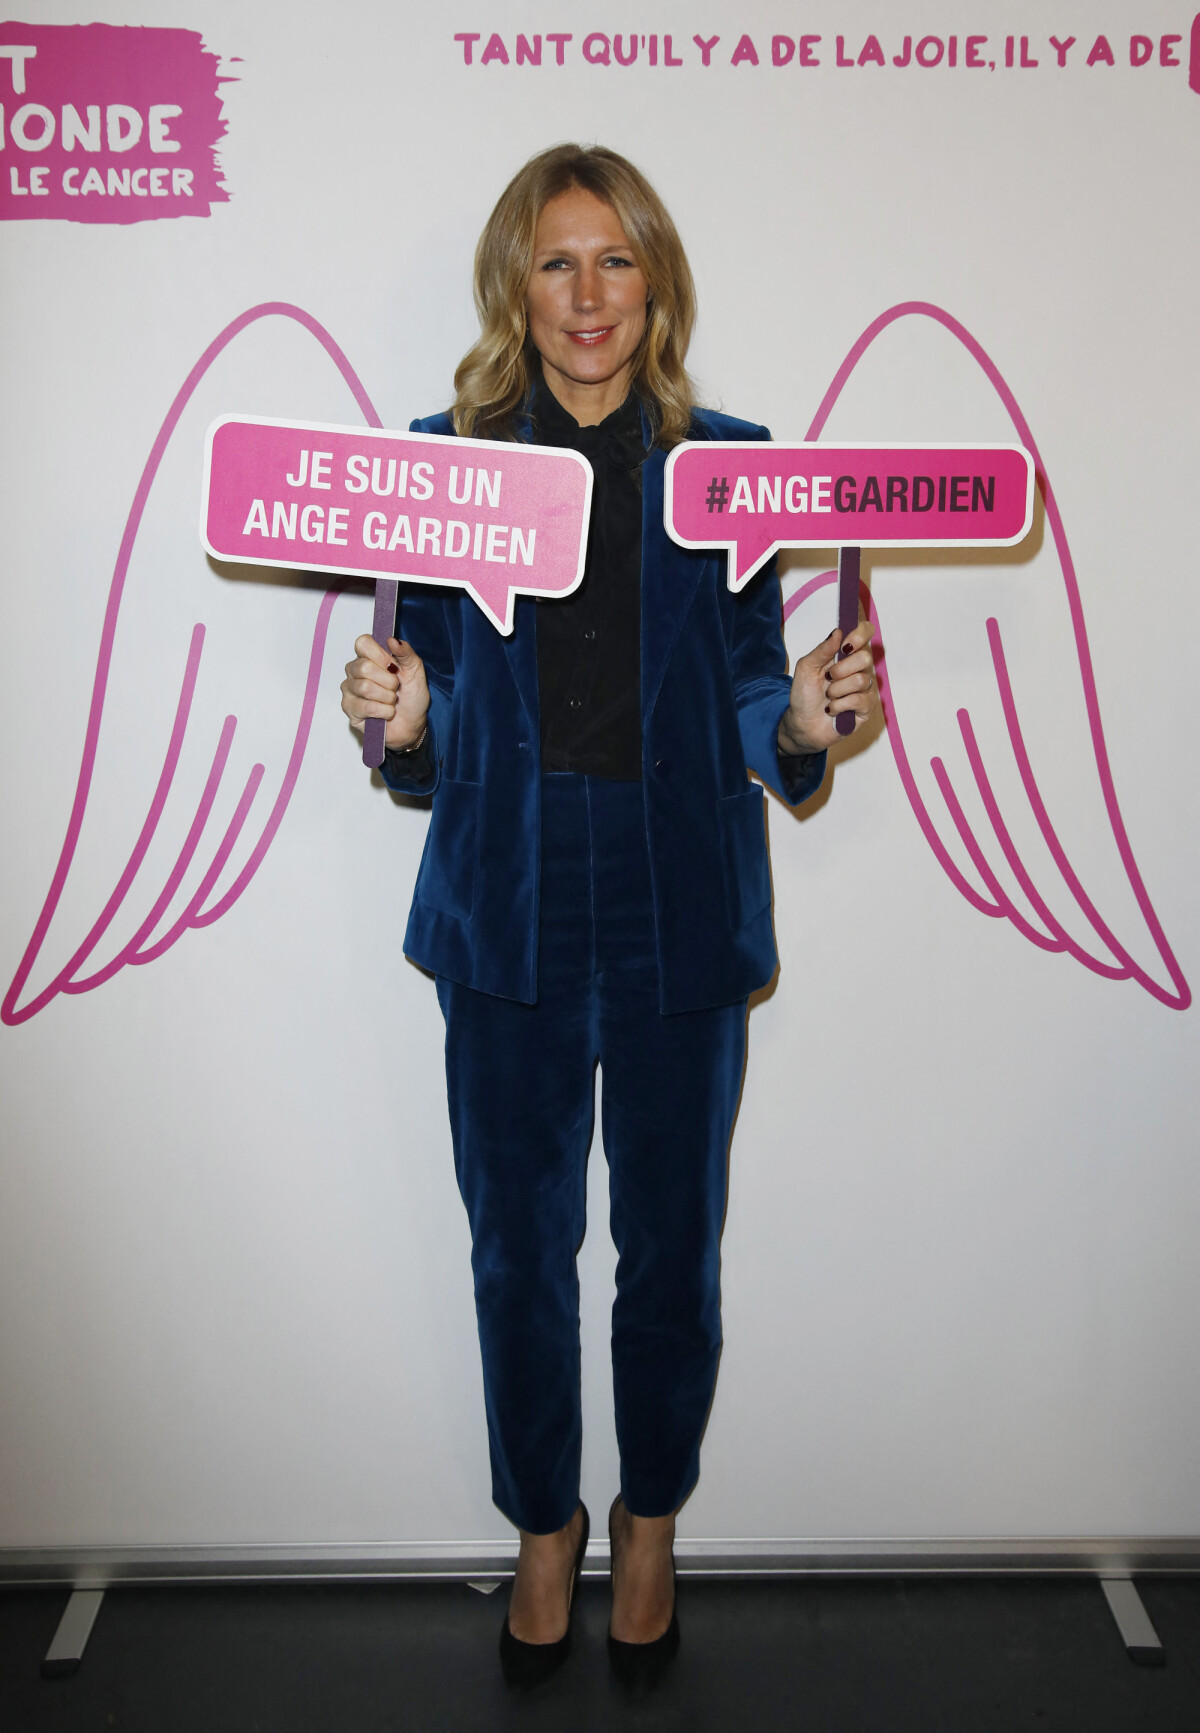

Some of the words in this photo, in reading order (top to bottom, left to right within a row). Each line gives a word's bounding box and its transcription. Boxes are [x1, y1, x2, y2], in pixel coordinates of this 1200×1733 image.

[454, 33, 573, 66] TANT
[582, 32, 683, 66] QU'IL
[693, 34, 720, 66] Y
[730, 34, 759, 66] A
[772, 35, 822, 67] DE
[836, 35, 885, 67] LA
[893, 35, 995, 72] JOIE,
[1005, 36, 1039, 68] IL
[1049, 36, 1076, 68] Y
[1086, 35, 1115, 67] A
[1130, 35, 1182, 67] DE
[0, 103, 183, 153] ONDE
[10, 167, 50, 196] LE
[62, 167, 194, 197] CANCER
[286, 450, 334, 490] JE
[344, 454, 435, 501] SUIS
[448, 466, 502, 508] UN
[705, 475, 996, 514] #ANGEGARDIEN
[242, 499, 351, 546] ANGE
[362, 511, 537, 566] GARDIEN
